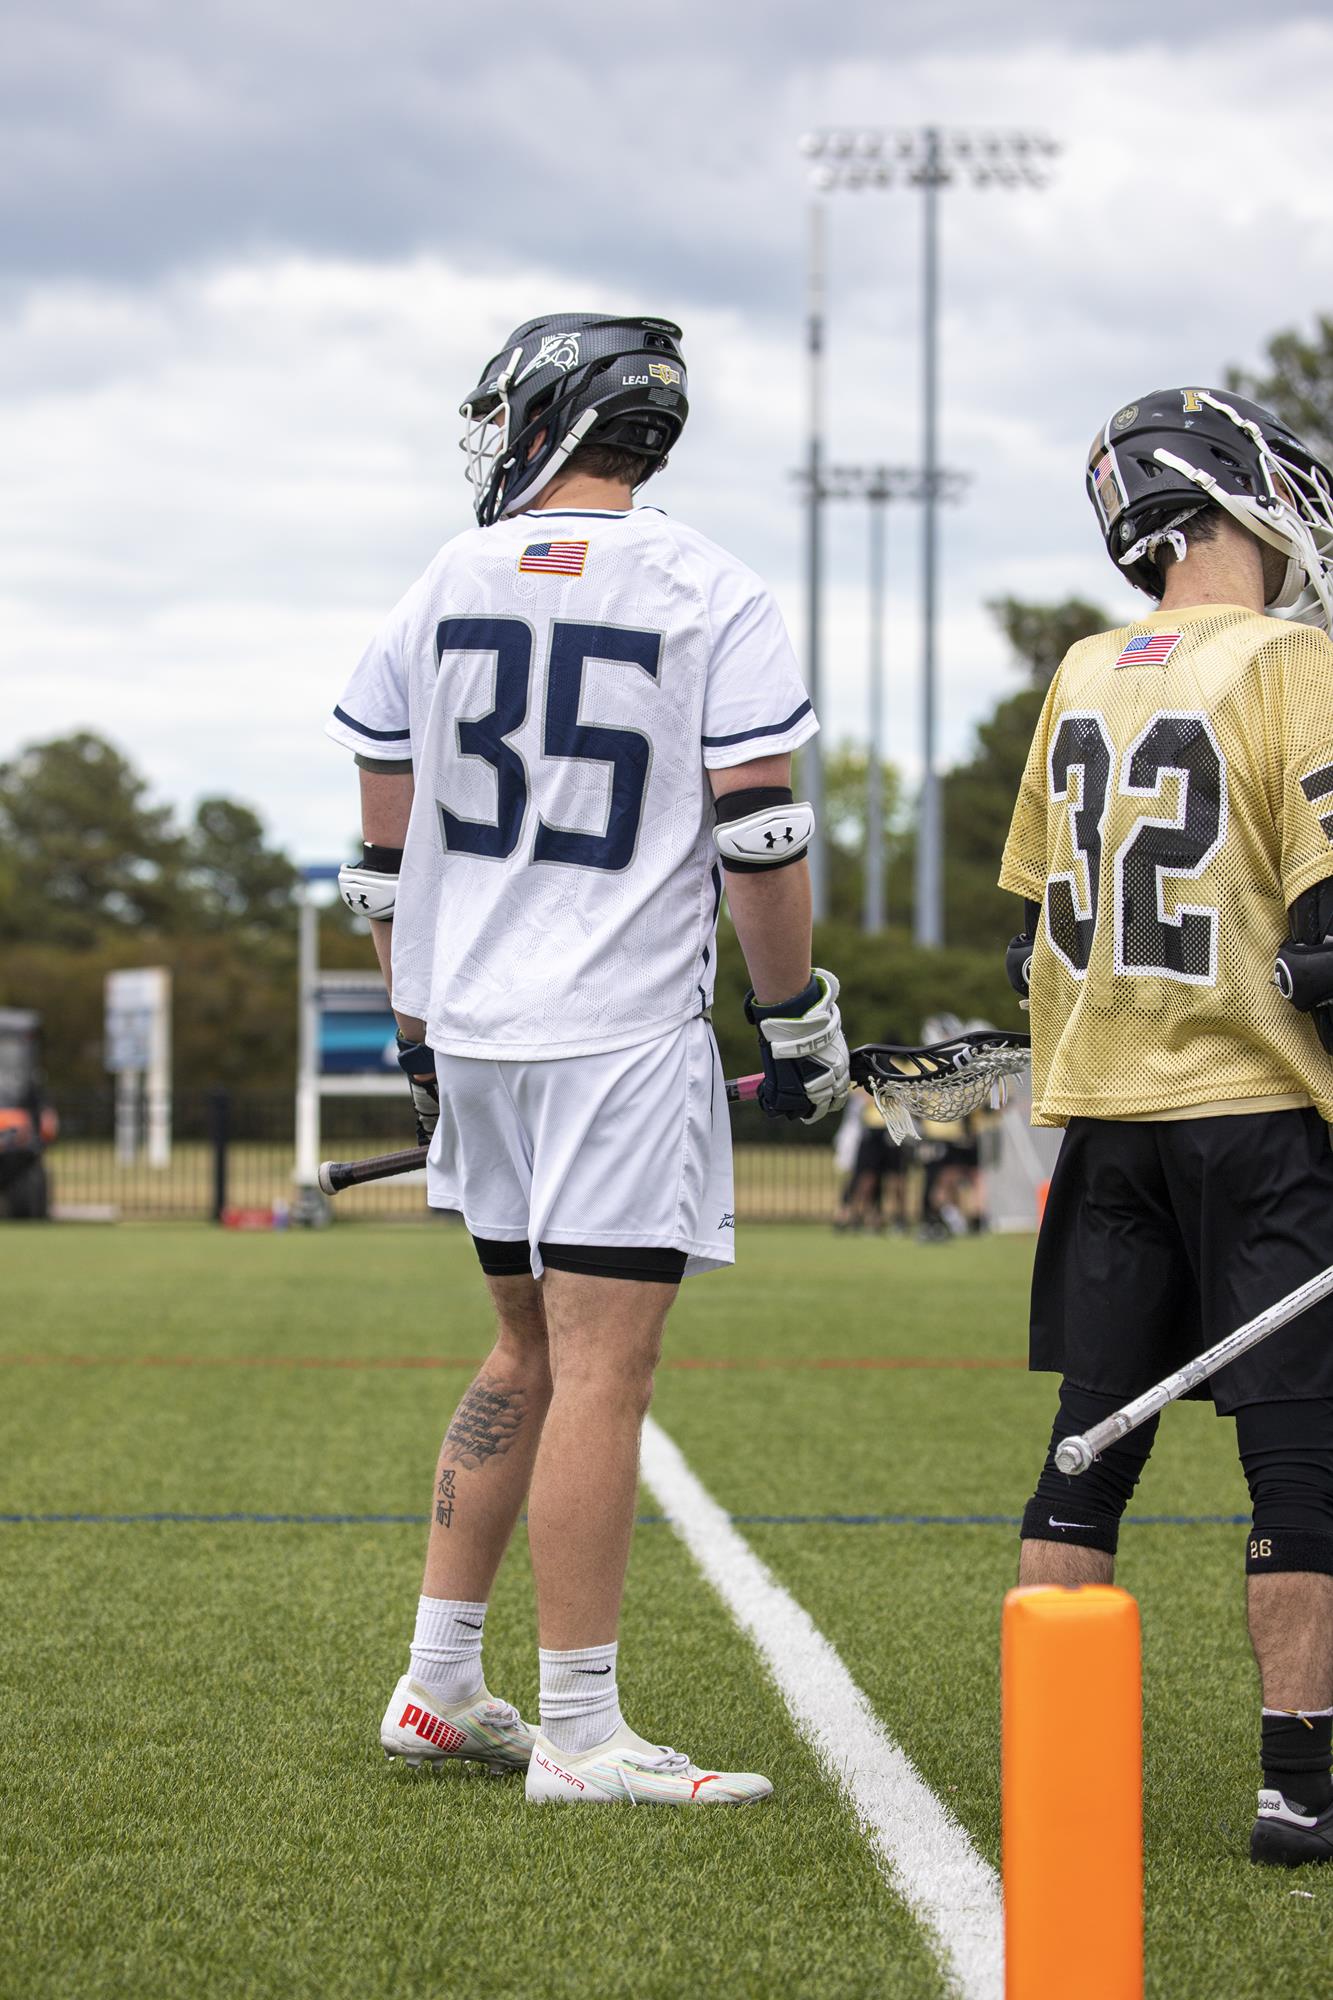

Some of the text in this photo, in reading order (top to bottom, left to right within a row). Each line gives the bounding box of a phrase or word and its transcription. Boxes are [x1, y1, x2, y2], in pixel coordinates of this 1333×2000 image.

[622, 375, 648, 385] LEAD
[1180, 389, 1210, 412] F
[433, 613, 667, 875] 35
[1046, 708, 1229, 987] 32
[435, 1468, 456, 1529] 忍耐
[1250, 1538, 1272, 1559] 26
[398, 1703, 468, 1753] PUMA
[536, 1752, 585, 1792] ULTRA
